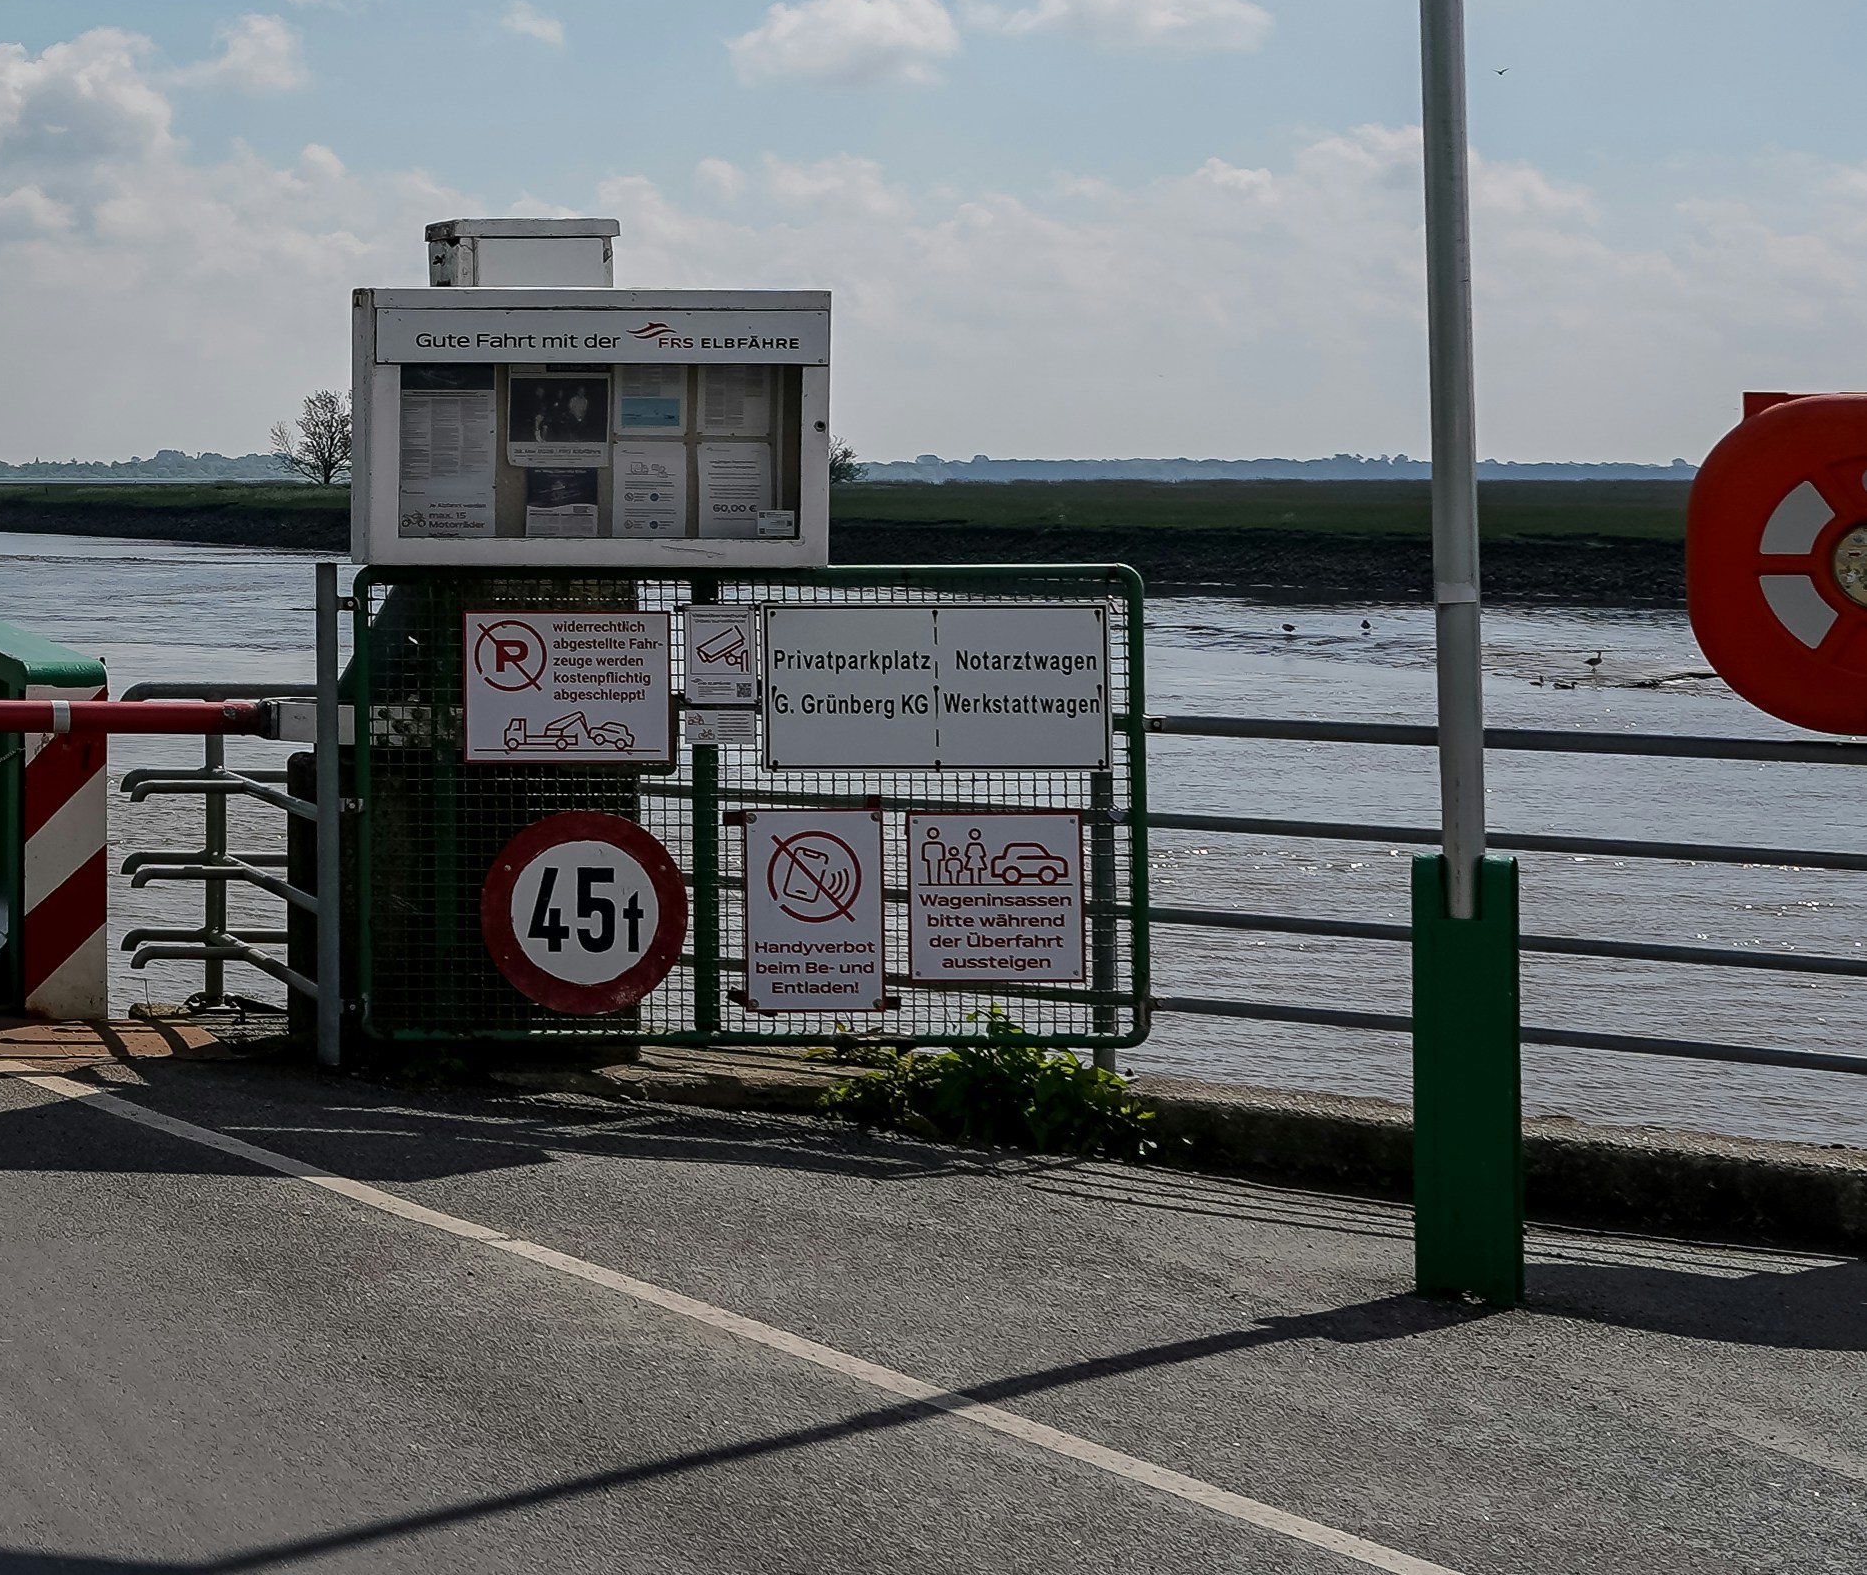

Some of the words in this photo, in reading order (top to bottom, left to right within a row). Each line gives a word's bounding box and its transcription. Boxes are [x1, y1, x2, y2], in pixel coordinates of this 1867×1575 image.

[415, 333, 470, 349] Gute
[476, 333, 536, 349] Fahrt
[542, 332, 578, 349] mit
[584, 333, 621, 349] der
[658, 337, 694, 350] FRS
[701, 335, 800, 350] ELBFÄHRE
[456, 511, 467, 520] 15
[712, 504, 747, 514] 60,00
[749, 504, 757, 513] €
[429, 520, 485, 530] Motorräder
[552, 621, 646, 633] widerrechtlich
[552, 638, 626, 650] abgestellte
[629, 638, 664, 650] Fahr-
[553, 656, 592, 667] zeuge
[596, 655, 644, 667] werden
[773, 650, 931, 675] Privatparkplatz
[955, 650, 1097, 675] Notarztwagen
[553, 672, 651, 685] kostenpflichtig
[553, 689, 646, 702] abgeschleppt!
[774, 694, 794, 715] G.
[801, 694, 894, 719] Grünberg
[901, 694, 929, 715] KG
[943, 693, 1101, 718] Werkstattwagen
[918, 893, 1072, 910] Wageninsassen
[927, 914, 974, 927] bitte
[978, 914, 1065, 927] während
[929, 935, 962, 949] der
[966, 932, 1064, 949] Überfahrt
[754, 941, 876, 956] Handyverbot
[755, 961, 800, 974] beim
[805, 961, 835, 974] Be-
[839, 961, 875, 974] und
[942, 955, 1052, 971] aussteigen
[772, 981, 860, 994] Entladen!
